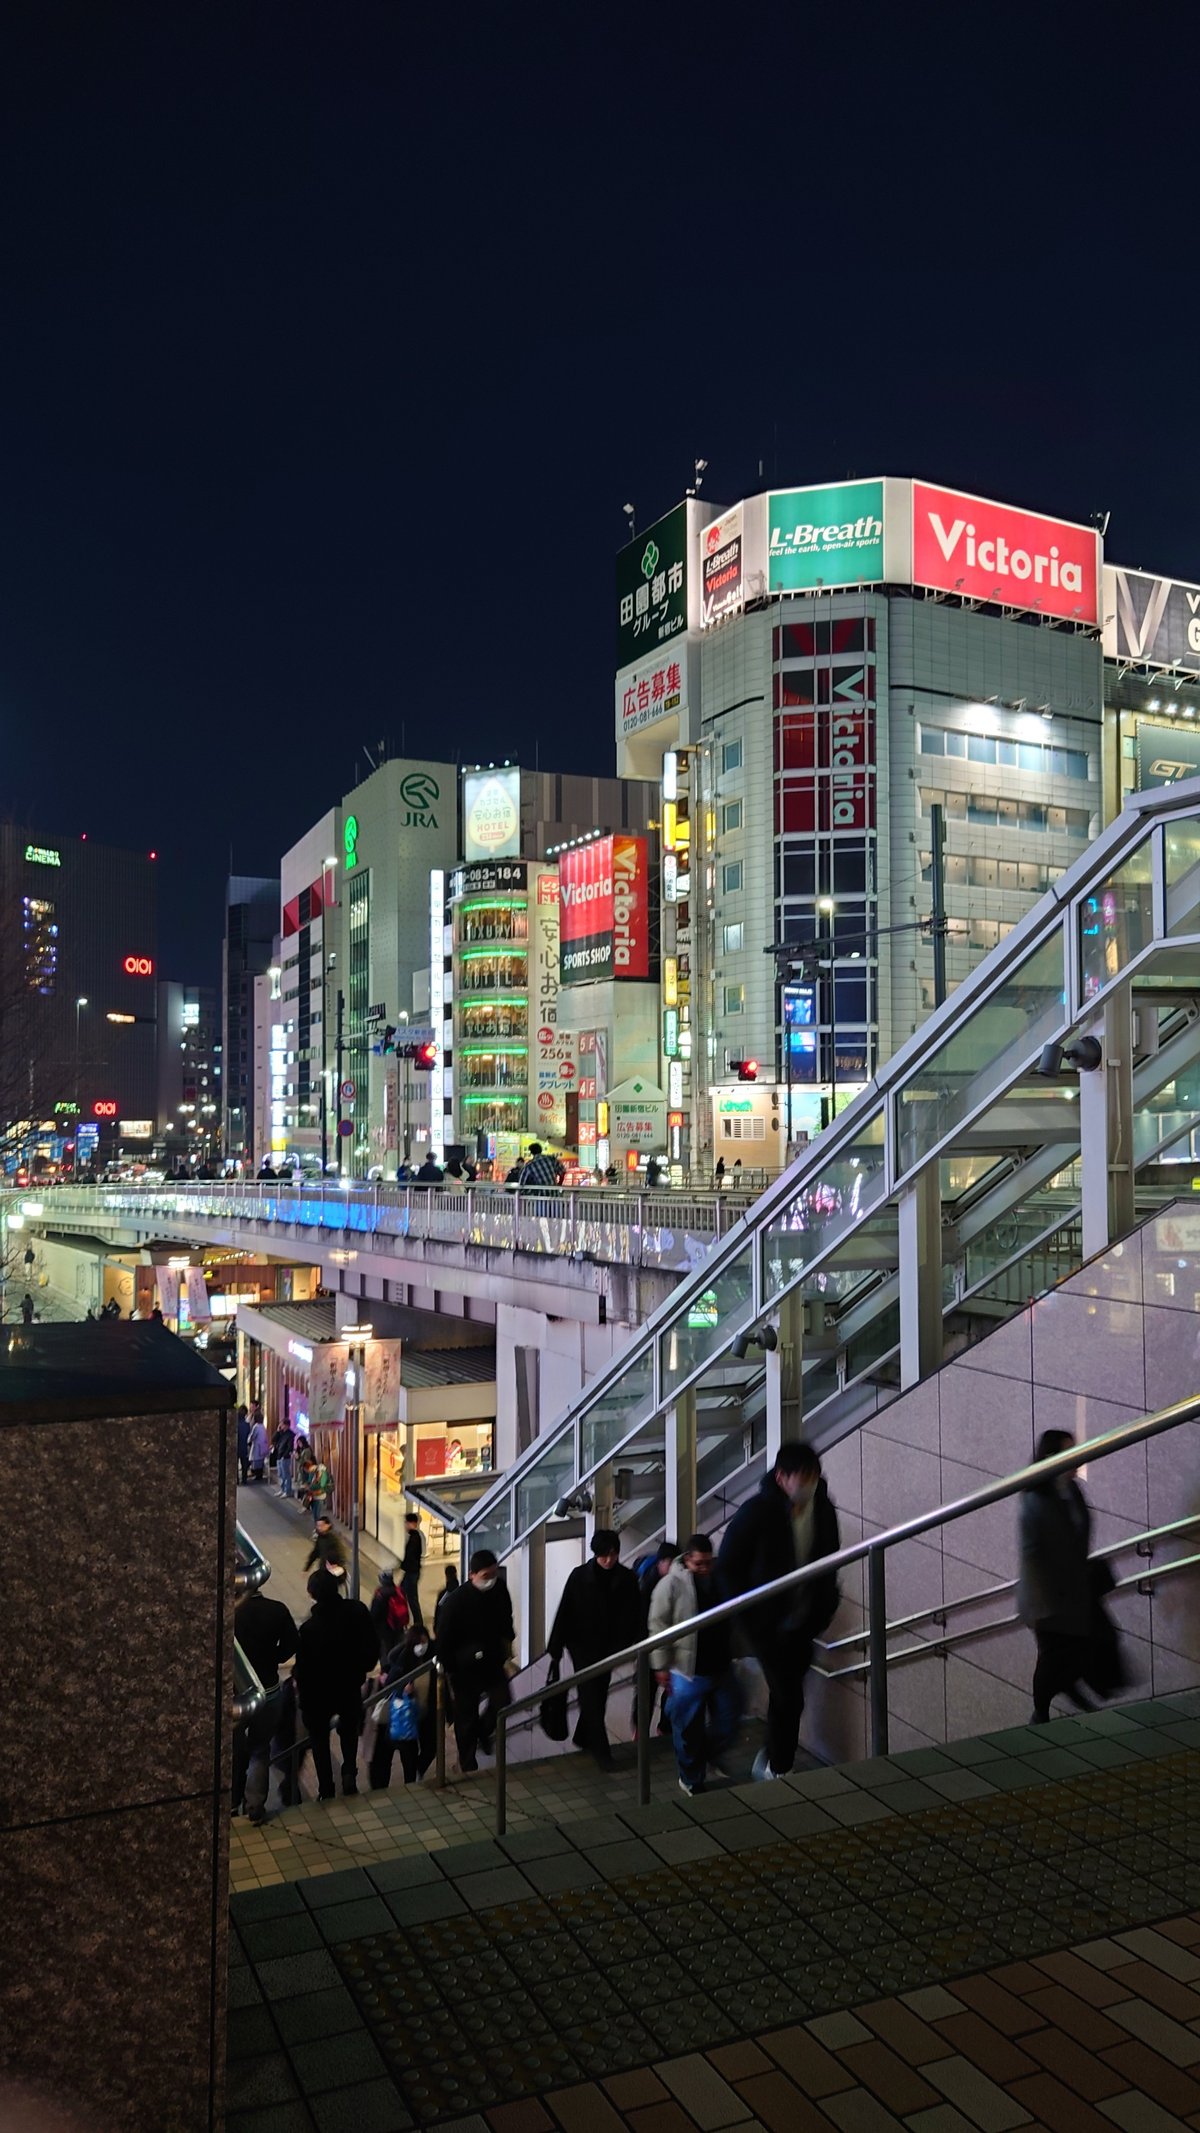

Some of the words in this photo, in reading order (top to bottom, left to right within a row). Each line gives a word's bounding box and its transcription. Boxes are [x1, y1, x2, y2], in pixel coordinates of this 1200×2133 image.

[770, 515, 883, 548] L-Breath
[769, 547, 783, 556] feel
[785, 546, 797, 555] the
[822, 540, 854, 552] open-air
[856, 537, 880, 548] sports
[928, 512, 1082, 593] Victoria
[706, 565, 738, 593] Victoria
[620, 561, 683, 627] 田園都市
[622, 662, 681, 719] 広告募集
[1149, 759, 1197, 779] GT
[400, 812, 439, 829] JRA
[25, 852, 61, 867] CINEMA
[560, 873, 612, 908] Victoria
[613, 844, 640, 966] Victoria
[563, 949, 591, 970] SPORTS
[590, 944, 612, 964] SHOP
[617, 1121, 653, 1132] 広告募集
